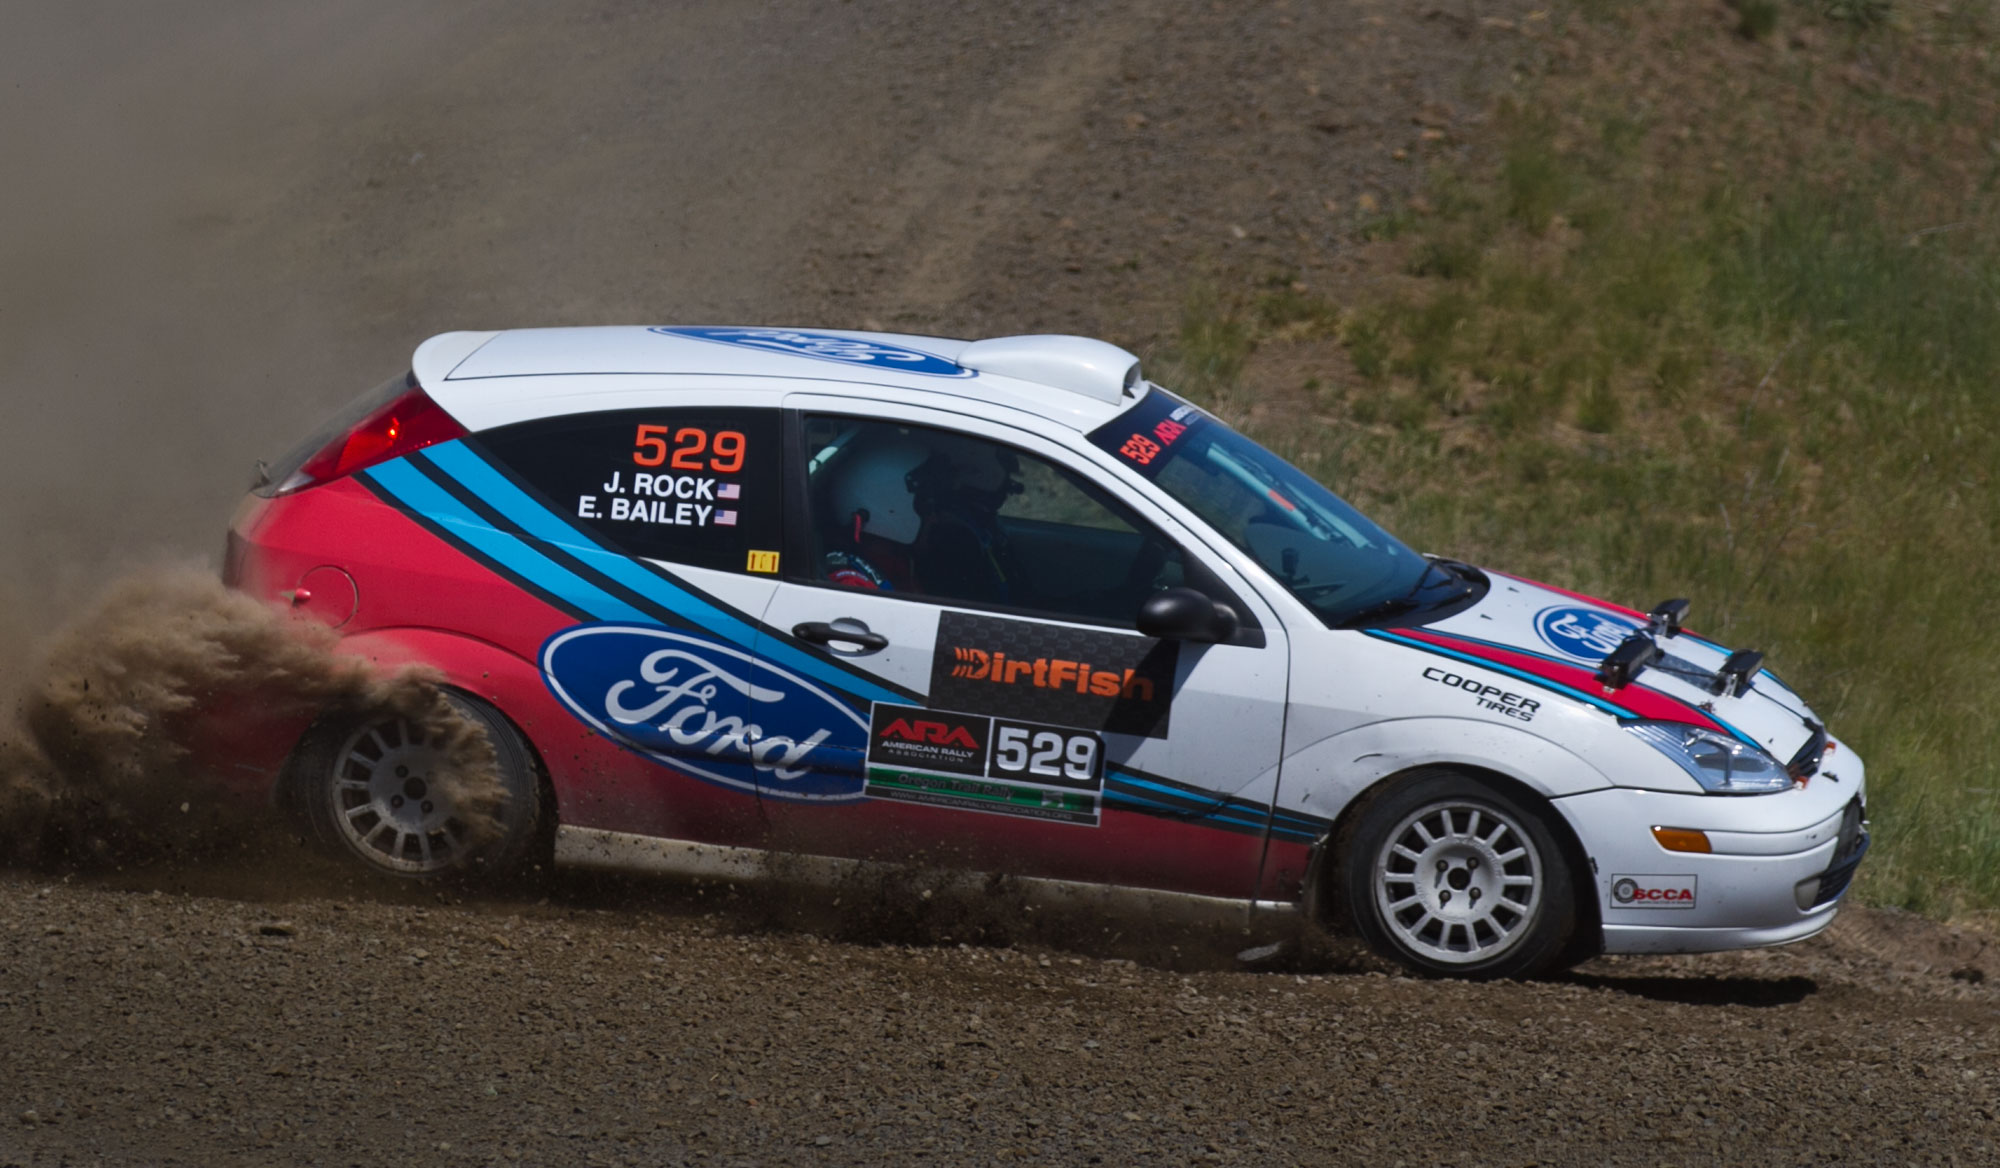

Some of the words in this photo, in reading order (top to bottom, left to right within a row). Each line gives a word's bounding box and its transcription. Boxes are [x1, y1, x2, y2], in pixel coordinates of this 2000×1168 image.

[633, 424, 746, 472] 529
[1120, 433, 1161, 465] 529
[1153, 419, 1187, 446] ARA
[603, 471, 625, 493] J.
[634, 473, 715, 500] ROCK
[578, 495, 602, 519] E.
[611, 498, 712, 526] BAILEY
[952, 647, 1153, 700] DirtFish
[1422, 667, 1541, 713] COOPER
[605, 649, 832, 781] Ford
[1476, 696, 1534, 722] TIRES
[879, 718, 980, 750] ARA
[882, 740, 939, 754] AMERICAN
[940, 748, 974, 759] RALLY
[888, 749, 963, 763] ASSOCIATION
[996, 726, 1097, 780] 529
[898, 774, 949, 790] Oregon
[951, 780, 981, 793] Trail
[982, 784, 1016, 800] Rally
[1632, 888, 1693, 901] SCCA
